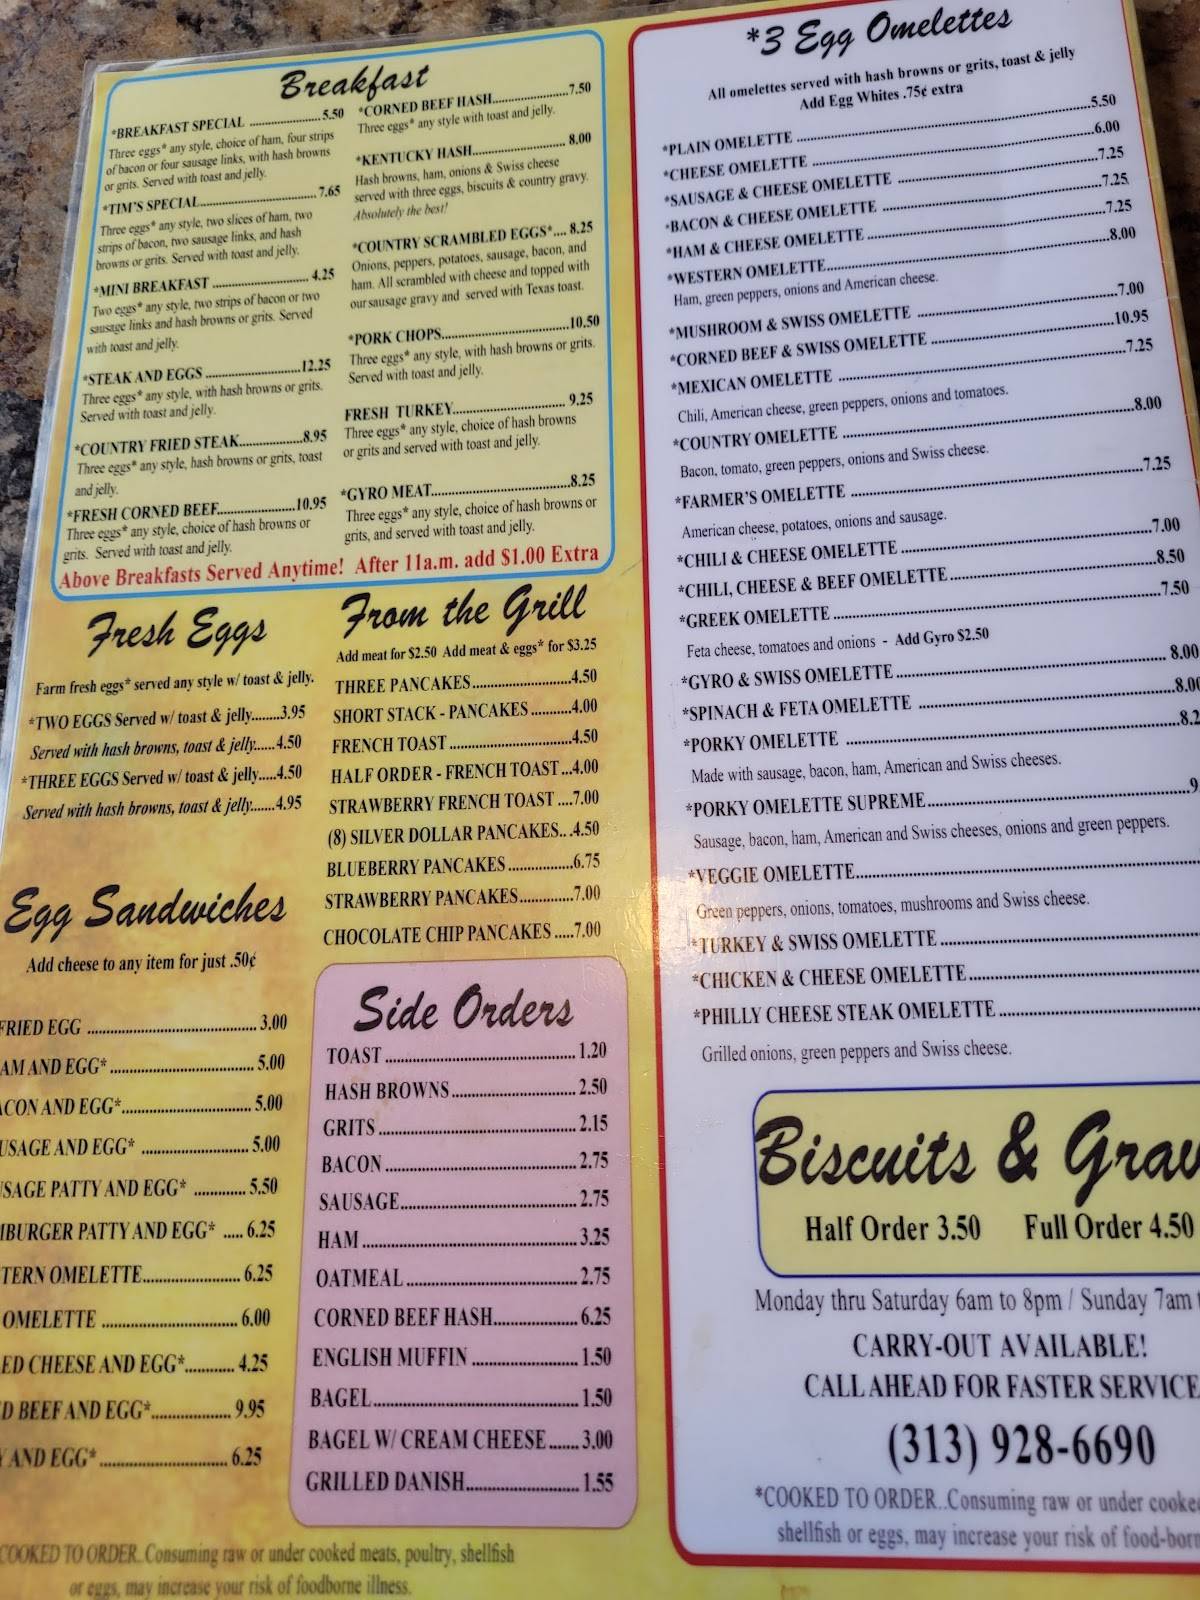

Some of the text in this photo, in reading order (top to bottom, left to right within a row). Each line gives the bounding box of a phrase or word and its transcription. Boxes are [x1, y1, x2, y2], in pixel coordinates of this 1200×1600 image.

[794, 18, 855, 60] Egg
[866, 6, 1013, 43] Omelettes
[280, 64, 428, 100] Breakfast
[800, 95, 825, 110] Add
[829, 94, 854, 109] Egg
[856, 90, 899, 103] Whites
[931, 83, 963, 96] extra
[191, 116, 241, 131] SPECIAL
[714, 131, 792, 150] OMELETTE
[105, 147, 331, 176] of bacon or four sausage links, with hash browns
[355, 157, 559, 186] Hash browns, ham, onions & Swiss cheese
[738, 187, 748, 200] &
[752, 181, 808, 198] CHEESE
[812, 172, 892, 192] OMELETTE
[766, 317, 777, 331] &
[781, 314, 825, 329] SWISS
[828, 305, 911, 325] OMELETTE
[741, 345, 777, 361] BEEF
[781, 344, 792, 358] &
[796, 340, 840, 356] SWISS
[843, 331, 927, 352] OMELETTE
[135, 369, 163, 383] AND
[166, 366, 202, 381] EGGS
[82, 392, 111, 405] Three
[144, 392, 163, 404] any
[166, 386, 192, 403] style,
[195, 384, 217, 398] with
[219, 383, 243, 397] hash
[245, 382, 282, 395] browns
[284, 383, 296, 393] or
[297, 379, 322, 395] grits.
[754, 425, 838, 445] OMELETTE
[680, 443, 989, 478] Bacon, tomato, green peppers, onions and Swiss cheese.
[59, 545, 599, 589] Above Breakfasts Served Anytime! After 11a.m. add $1.00 Extra
[341, 583, 587, 639] From the Grill
[87, 606, 267, 658] Fresh Eggs
[687, 644, 711, 658] Feta
[714, 642, 755, 657] cheese,
[758, 641, 810, 654] tomatoes
[813, 635, 834, 651] and
[837, 634, 876, 650] onions
[895, 631, 920, 646] Add
[923, 630, 955, 647] Gyro
[956, 627, 989, 642] $2.50
[762, 702, 774, 718] &
[779, 700, 819, 717] FETA
[822, 694, 911, 714] OMELETTE
[332, 735, 447, 754] FRENCH TOAST
[691, 751, 1061, 783] Made with sausage, bacon, ham, American and Swiss cheeses.
[3, 882, 287, 943] Egg Sandwiches
[26, 956, 54, 973] Add
[57, 956, 99, 972] cheese
[103, 957, 115, 971] to
[118, 958, 142, 974] any
[146, 953, 174, 970] item
[179, 953, 199, 969] for
[200, 952, 226, 972] just
[353, 983, 574, 1032] Side Orders
[47, 1018, 81, 1035] EGG
[260, 1013, 287, 1031] 3.00
[326, 1041, 606, 1064] TOAST 1.20
[702, 1038, 1012, 1065] Grilled onions, green peppers and Swiss cheese.
[322, 1151, 608, 1173] BACON 2.75
[755, 1111, 1038, 1186] Biscuits &
[805, 1214, 981, 1241] Half Order 3.50
[1024, 1211, 1194, 1240] Full Order 4.50
[2, 1308, 270, 1328] OMELETTE 6.00
[313, 1346, 611, 1367] ENGLISH MUFFIN 1.50
[853, 1333, 1147, 1358] CARRY-OUT AVAILABLE!
[888, 1423, 1155, 1474] (313) 928-6690
[308, 1542, 515, 1568] cooked meats, poultry, shellfish
